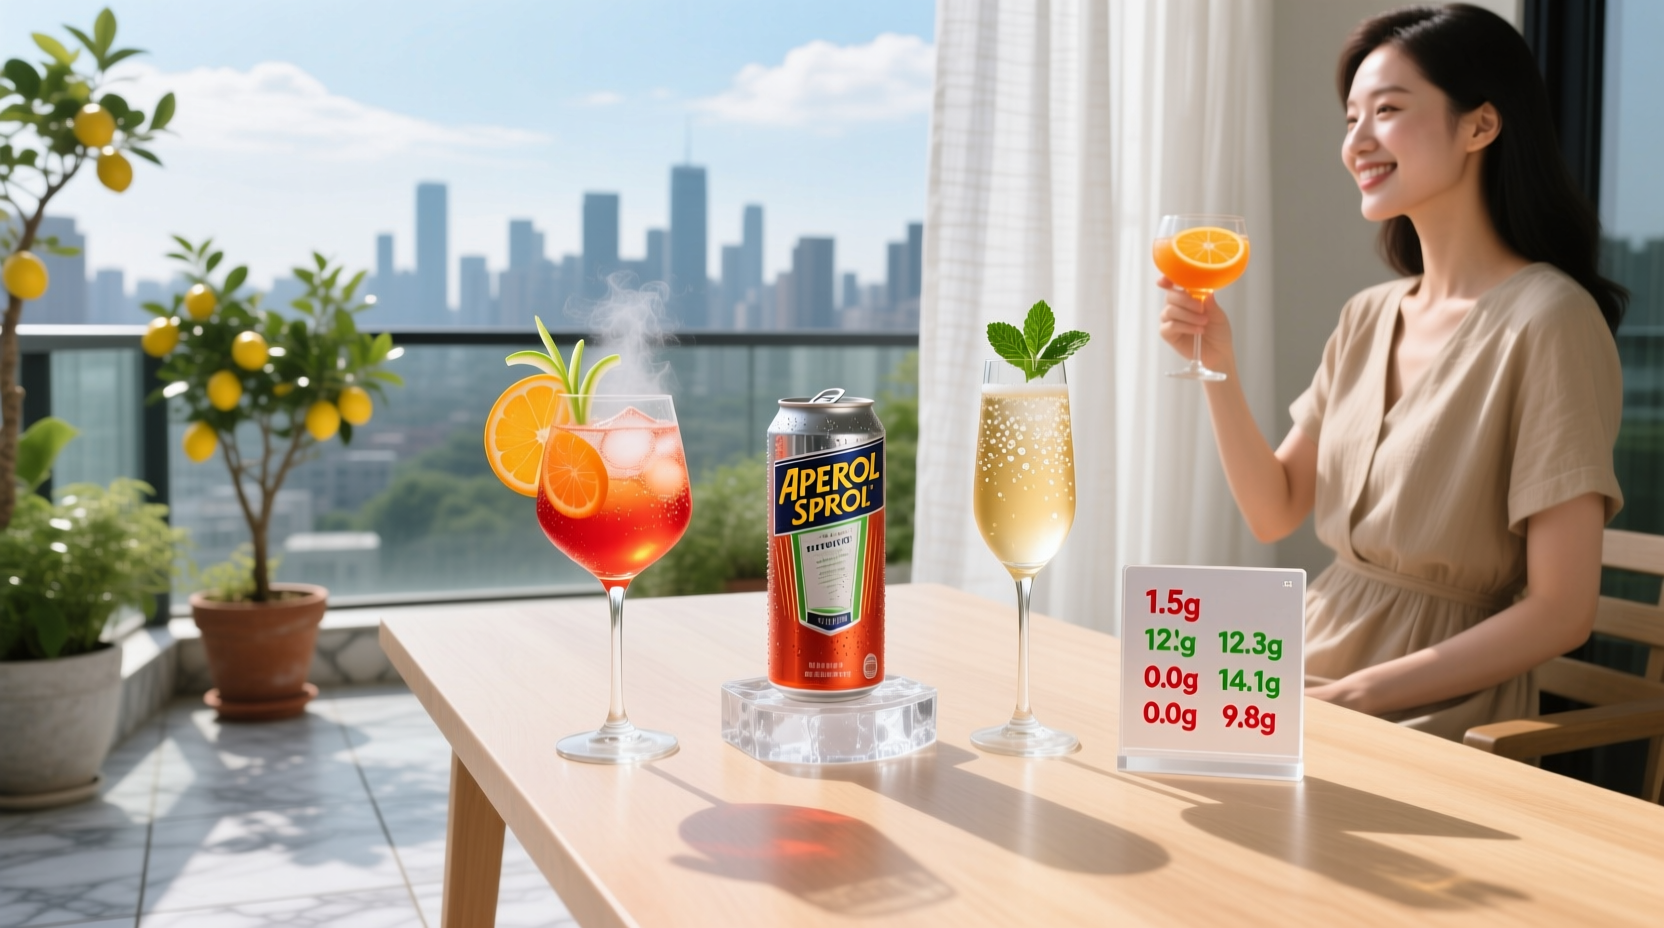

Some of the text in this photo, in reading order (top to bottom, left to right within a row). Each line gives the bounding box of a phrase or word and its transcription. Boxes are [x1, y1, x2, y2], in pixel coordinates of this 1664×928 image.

[779, 452, 880, 505] APEROL
[791, 486, 871, 526] SPROL
[1145, 588, 1200, 622] 1.5g
[1218, 630, 1283, 661] 12.3g
[1143, 665, 1281, 699] 0.0g 14.1g
[1143, 700, 1276, 735] 0.0g 9.8g
